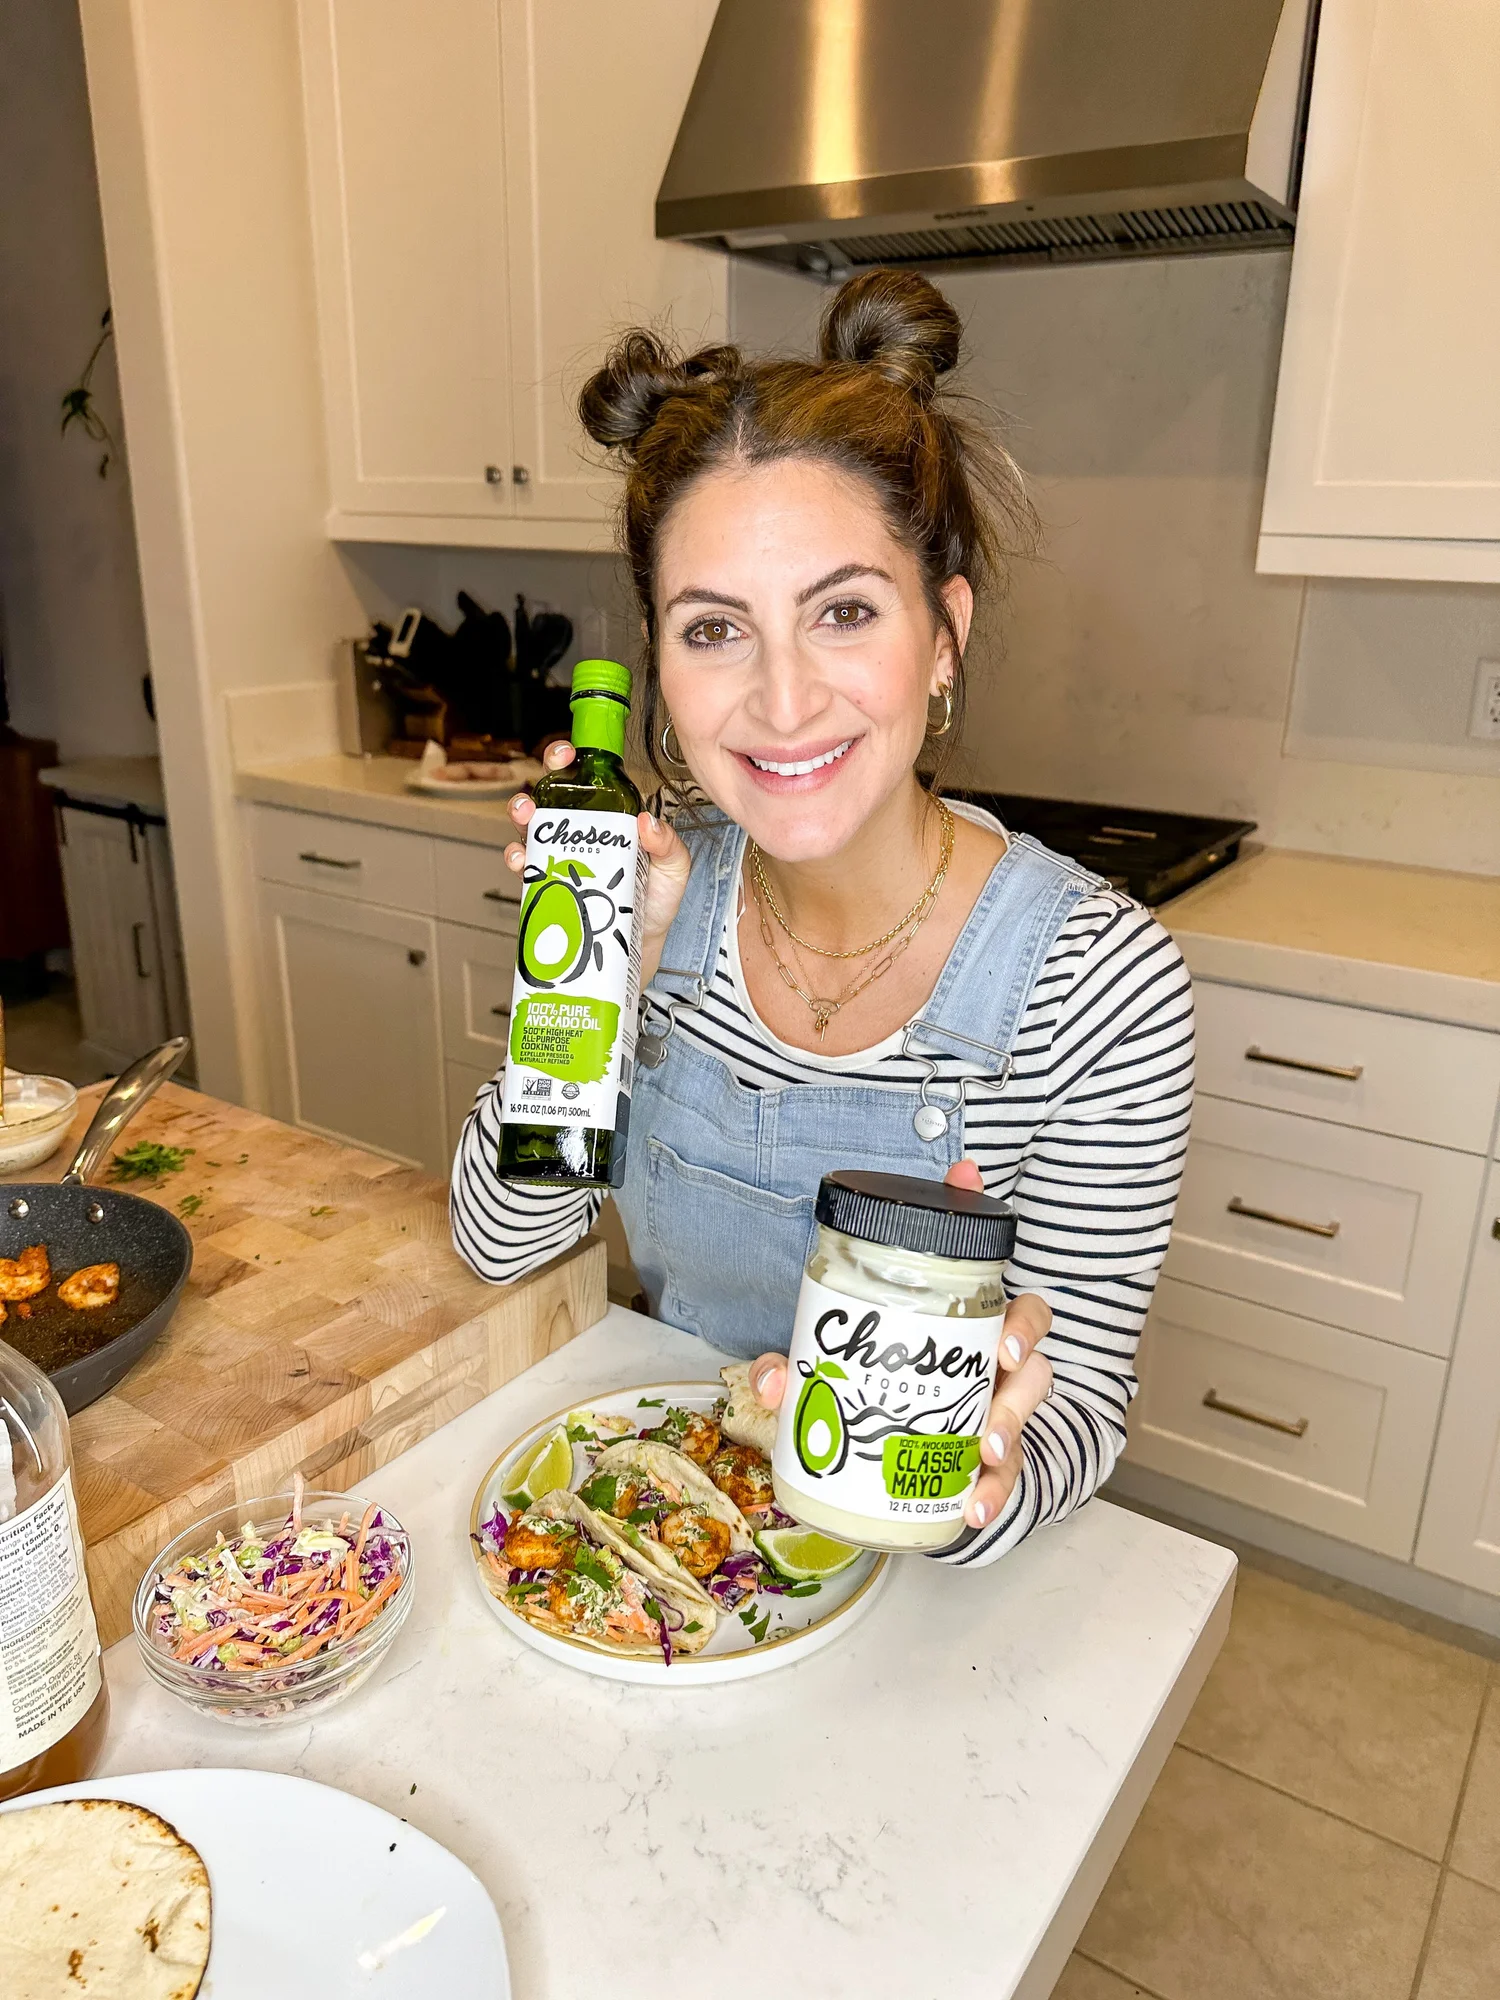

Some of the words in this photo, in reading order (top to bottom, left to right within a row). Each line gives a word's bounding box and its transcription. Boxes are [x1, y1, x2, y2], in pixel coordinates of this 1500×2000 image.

[534, 818, 631, 848] Chosen
[563, 846, 601, 854] FOODS
[527, 1002, 558, 1016] 100%
[559, 1003, 592, 1017] PURE
[524, 1014, 580, 1029] AVOCADO
[581, 1017, 601, 1030] OIL
[521, 1035, 570, 1044] ALL-PURPOSE
[546, 1028, 564, 1037] HIGH
[565, 1030, 583, 1038] HEAT
[521, 1042, 554, 1051] COOKING
[555, 1044, 569, 1052] OIL
[510, 1103, 522, 1113] 16.9
[522, 1104, 529, 1114] FL
[530, 1104, 541, 1114] OZ
[541, 1105, 557, 1116] (1.06
[557, 1106, 567, 1117] PT)
[568, 1107, 591, 1118] 500mL
[814, 1308, 990, 1378] Chosen
[864, 1373, 941, 1397] FOODS
[899, 1438, 920, 1449] 100%
[920, 1441, 954, 1450] AVOCADO
[955, 1441, 964, 1449] OIL
[896, 1449, 964, 1474] CLASSIC
[891, 1471, 943, 1497] MAYO
[889, 1500, 900, 1512] 12
[901, 1502, 912, 1513] FL
[915, 1503, 930, 1514] OZ
[932, 1502, 950, 1515] (355
[0, 1522, 31, 1544] trition
[33, 1502, 54, 1523] Facts
[26, 1533, 53, 1555] Calories
[0, 1548, 20, 1561] Tbsp
[12, 1564, 23, 1573] Fat
[0, 1579, 24, 1594] holest.
[0, 1586, 23, 1601] odium
[1, 1611, 27, 1626] Protein
[1, 1618, 51, 1651] INGREDIENTS:
[12, 1682, 47, 1706] Certified
[48, 1660, 74, 1684] Organic
[13, 1693, 44, 1713] Oregon
[15, 1700, 48, 1722] Sediment
[16, 1714, 39, 1728] Shake
[40, 1703, 54, 1715] well
[54, 1687, 72, 1705] before
[18, 1718, 46, 1738] MADE
[47, 1710, 56, 1721] IN
[58, 1696, 72, 1712] THE
[73, 1681, 85, 1697] USA
